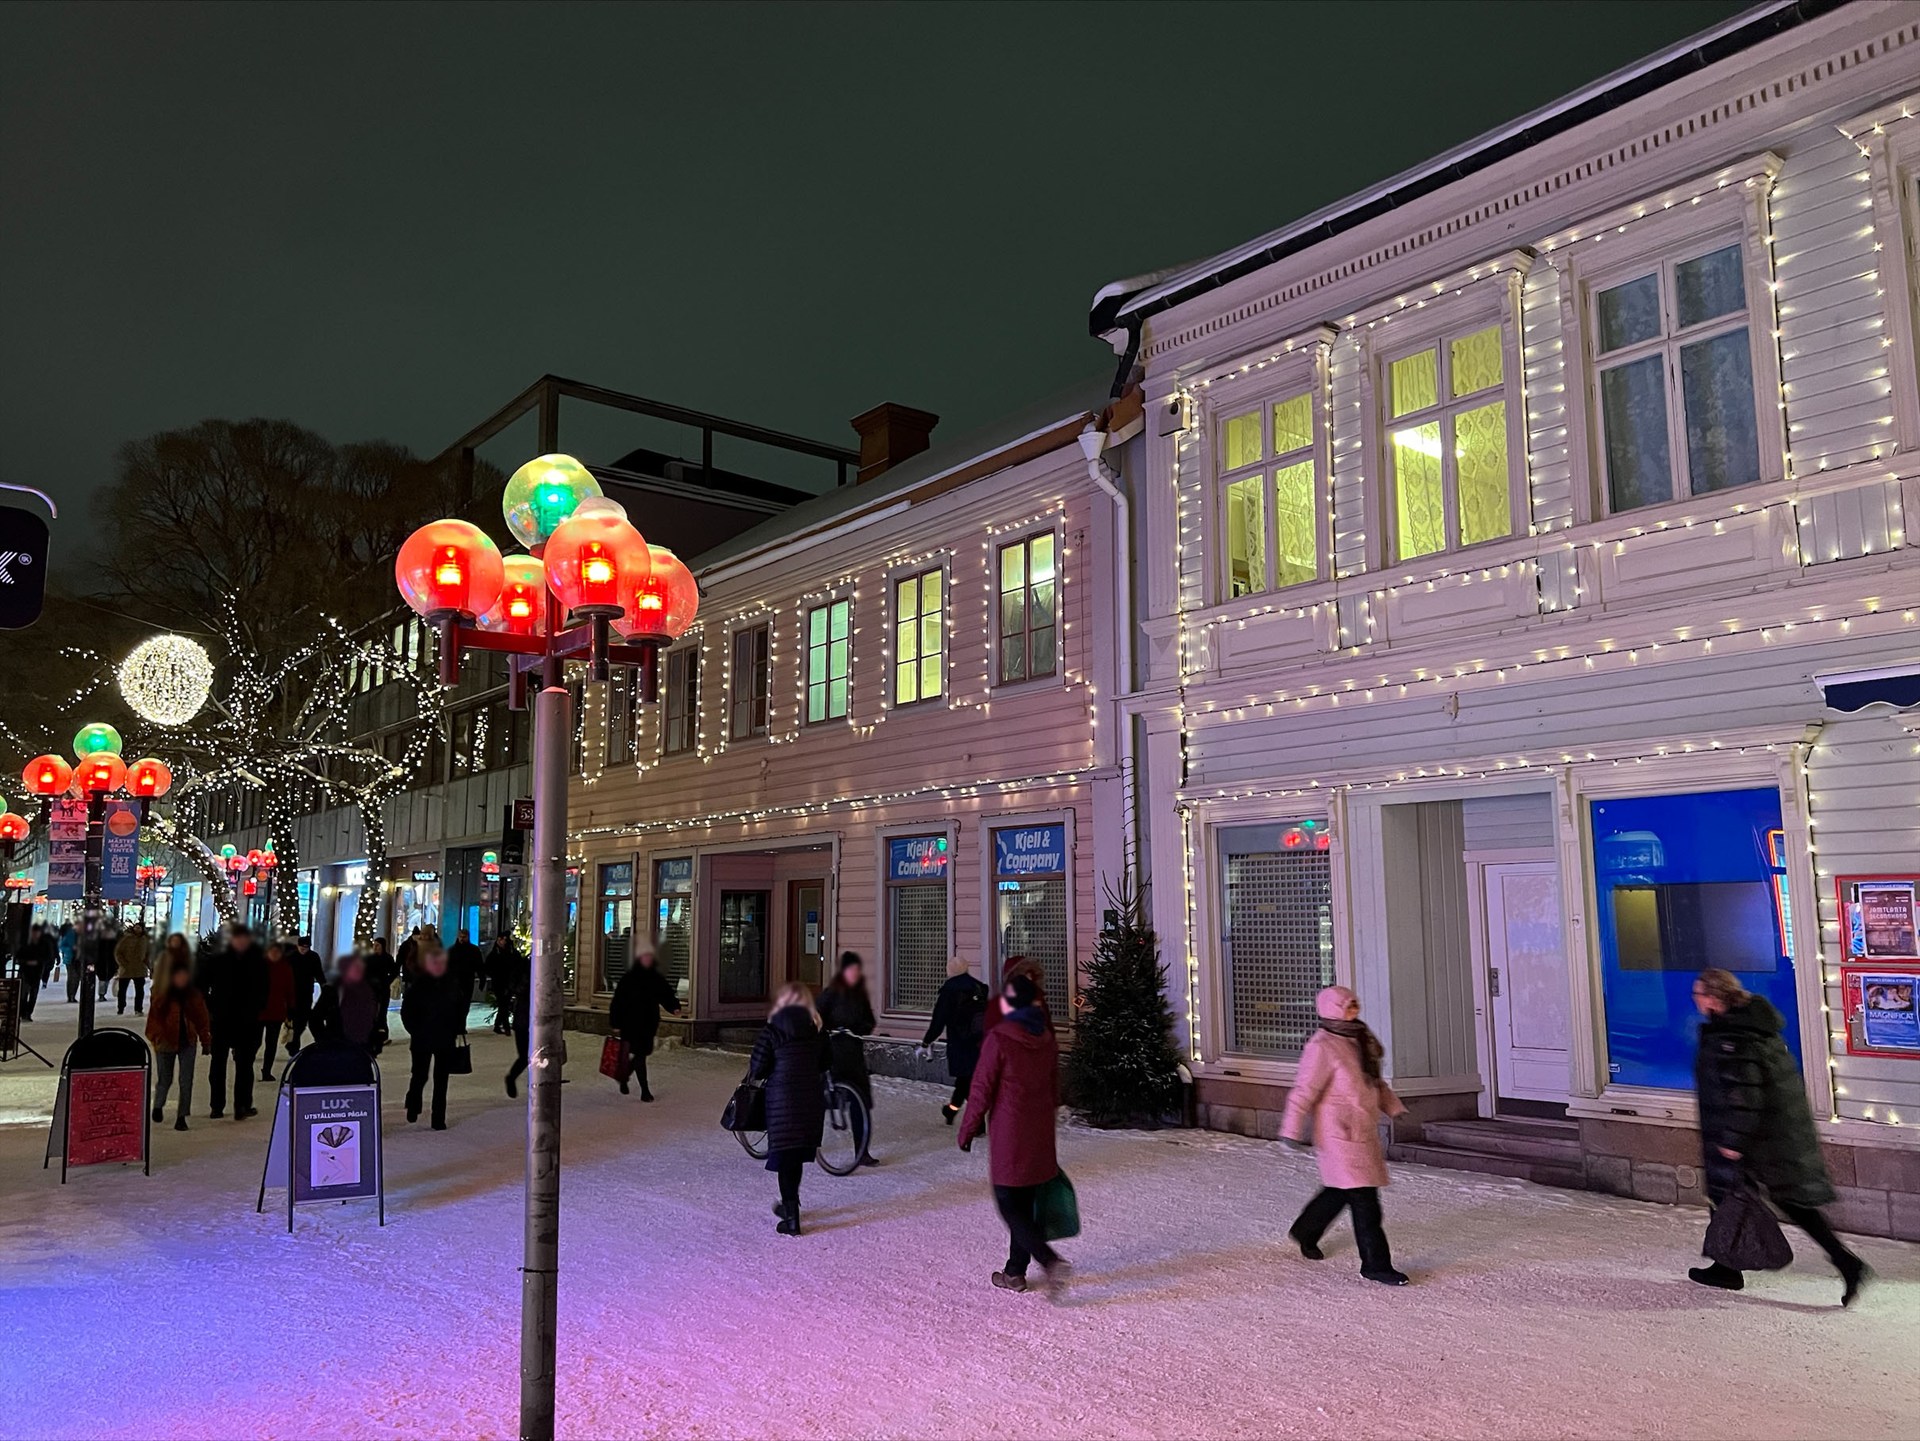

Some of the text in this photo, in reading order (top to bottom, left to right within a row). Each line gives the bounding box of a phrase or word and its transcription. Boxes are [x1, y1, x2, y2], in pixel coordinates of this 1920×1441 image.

[520, 808, 534, 821] 53
[1015, 830, 1051, 852] Kjell &
[906, 841, 929, 860] Kjell
[111, 854, 130, 864] ÖST
[1005, 852, 1060, 871] Company
[898, 860, 943, 877] Company
[414, 872, 436, 881] VOLT
[1869, 1011, 1914, 1020] MAGNIFICAT
[322, 1099, 351, 1110] LUX
[304, 1112, 347, 1120] UTSTÄLLNING
